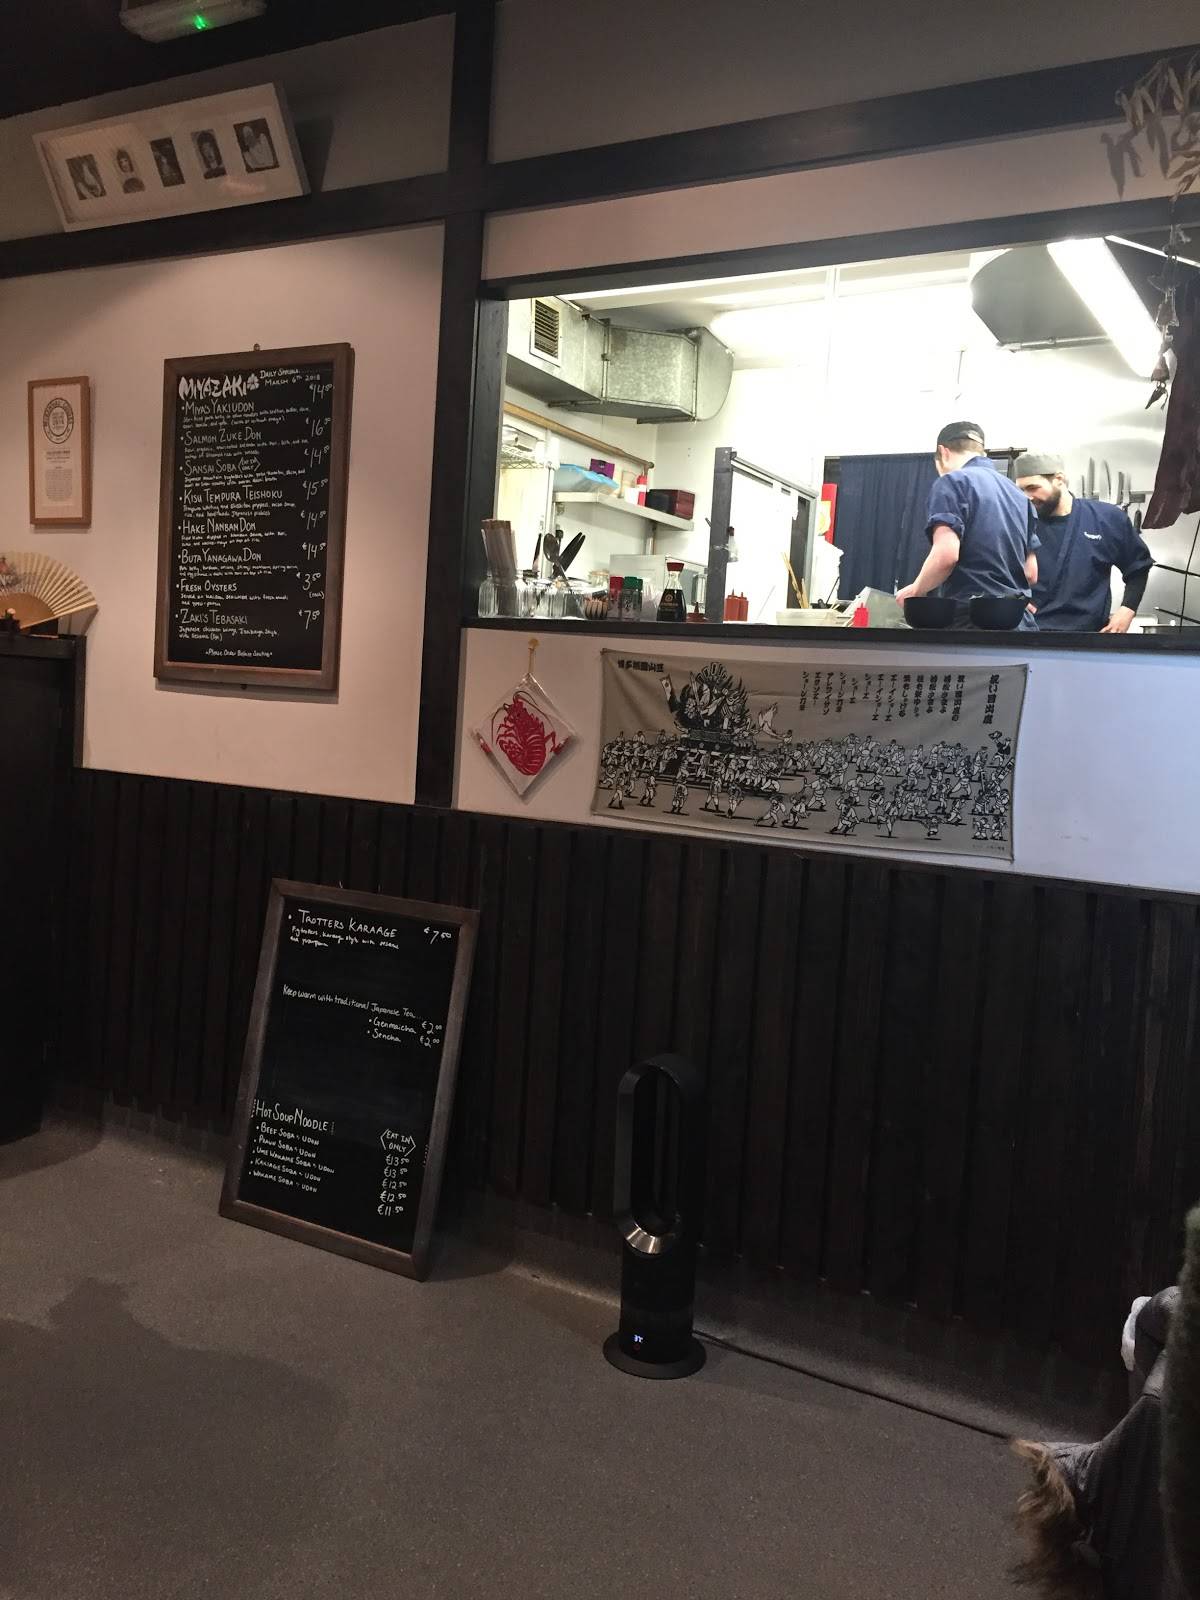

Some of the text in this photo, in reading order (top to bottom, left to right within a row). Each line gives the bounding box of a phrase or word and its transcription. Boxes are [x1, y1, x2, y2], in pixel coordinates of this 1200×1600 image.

[260, 369, 276, 379] DAILY
[178, 375, 247, 400] MIYAZAKI
[184, 425, 262, 446] SALMON ZUKE DON
[184, 458, 237, 476] SANSAI SOBA
[184, 484, 283, 504] KISU TEMPURA TEISHOKU
[182, 517, 256, 535] HAKE NANBAN DON
[181, 547, 262, 564] BUTA YANAGAWA DON
[180, 578, 238, 593] FRESH OYSTERS
[180, 608, 248, 625] ZAKI'S TEBASAKI
[298, 909, 398, 939] TROTTERS KARAAGE
[282, 983, 298, 998] Keep
[298, 990, 317, 1001] warm
[318, 994, 334, 1004] with
[334, 994, 370, 1010] traditional
[370, 1002, 401, 1018] Japanese
[373, 1016, 417, 1034] Genmaicha
[372, 1028, 401, 1043] Sencha
[255, 1099, 329, 1132] HOT SOUP NOODLE
[260, 1121, 320, 1146] BEEF SOBA UDON
[386, 1130, 412, 1144] EAT IN
[277, 1139, 294, 1152] SOBA
[299, 1148, 317, 1159] UDON
[388, 1142, 407, 1153] ONLY
[269, 1150, 295, 1164] WAKAME
[295, 1156, 311, 1168] SOBA
[318, 1164, 335, 1174] UDON
[253, 1170, 318, 1193] WAKAME SOBA UDON
[281, 1164, 297, 1176] SOBA
[304, 1171, 321, 1182] UDON
